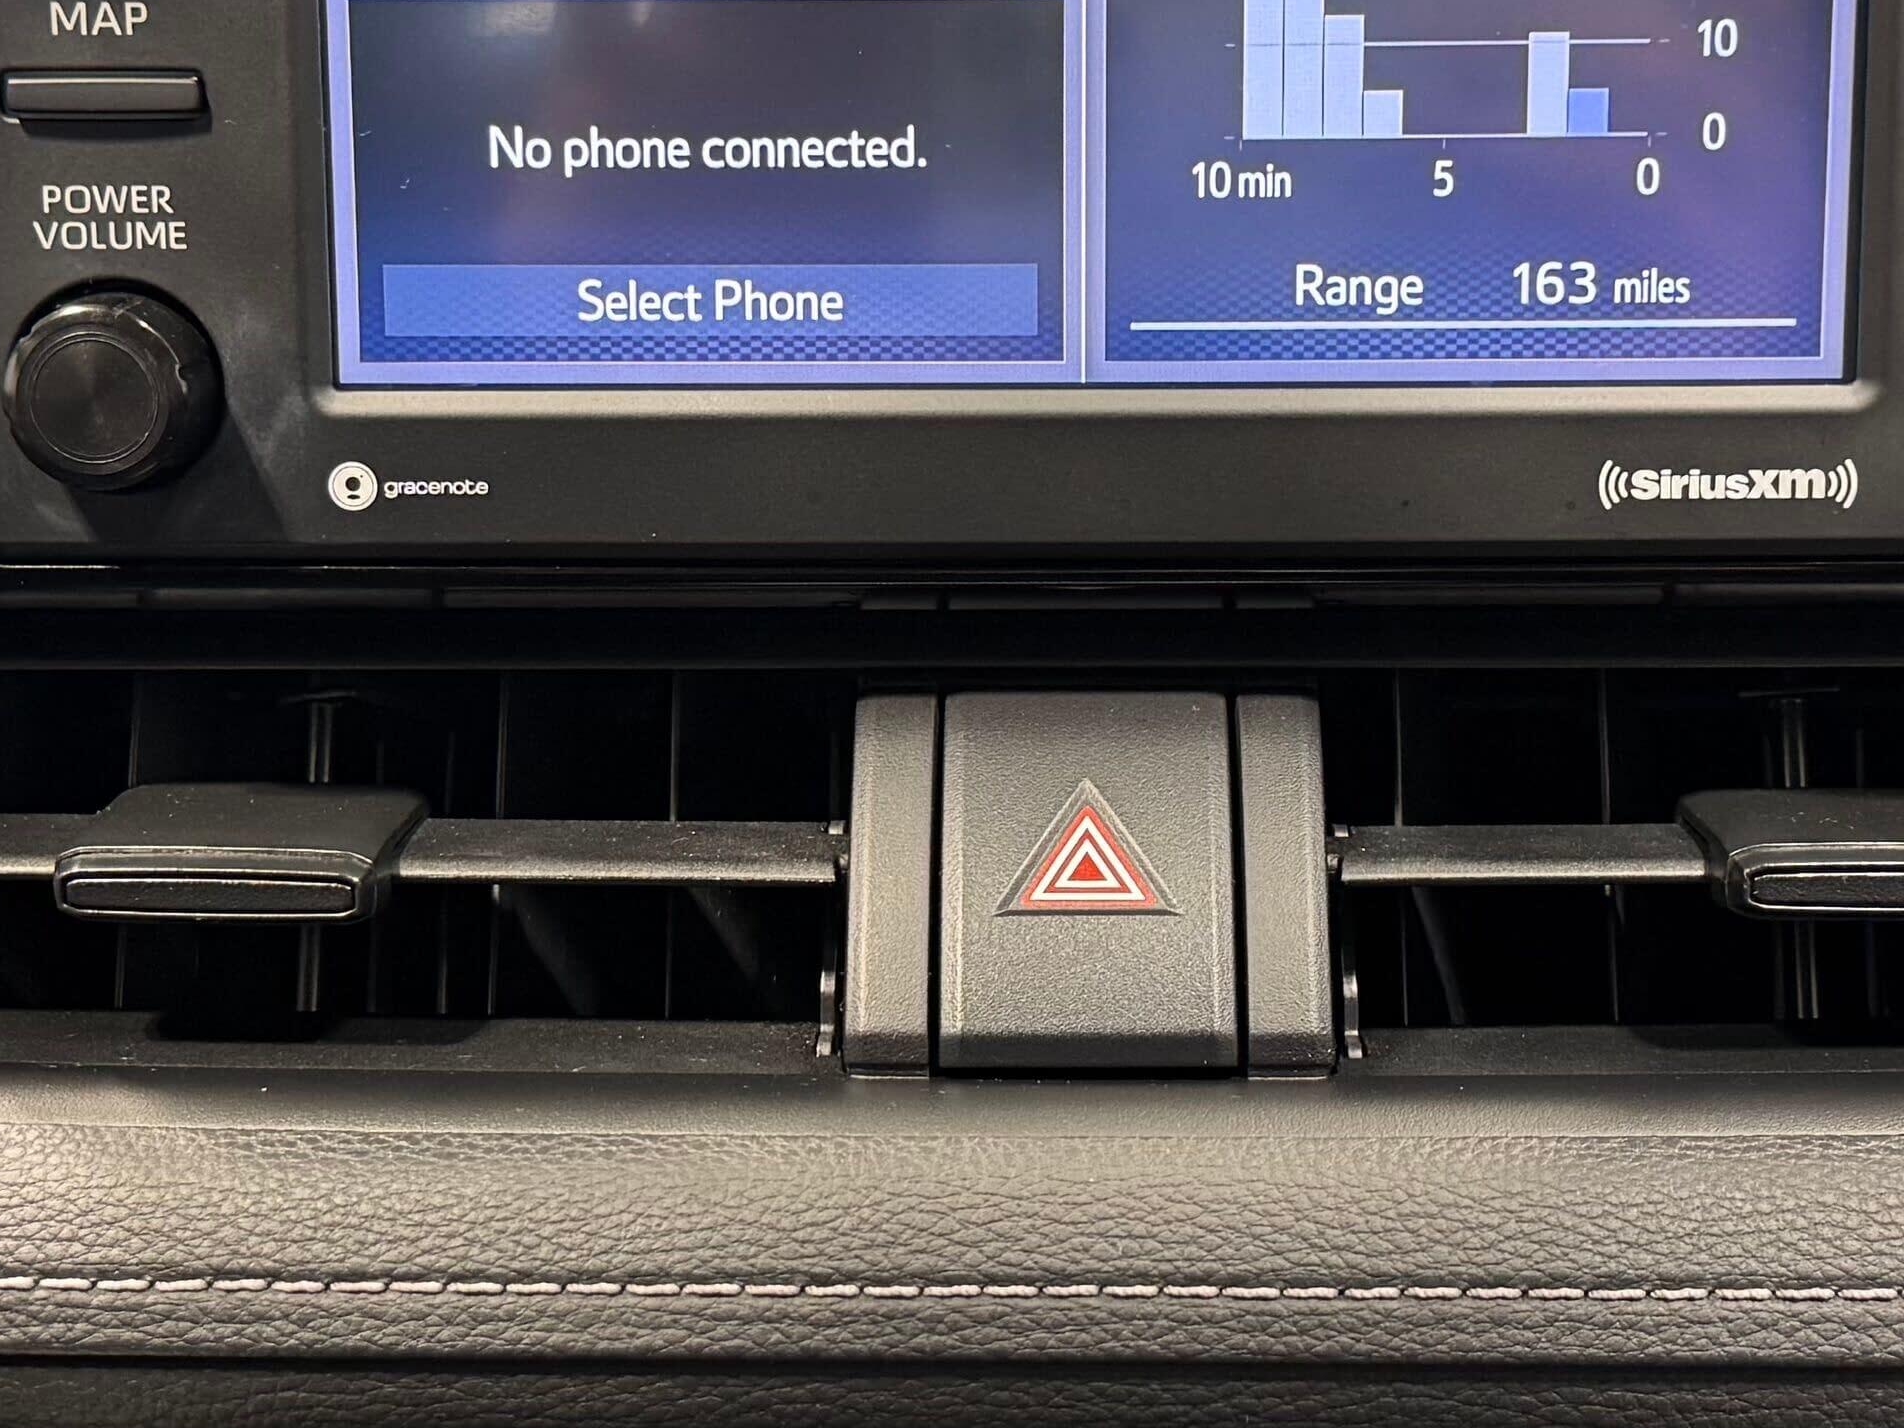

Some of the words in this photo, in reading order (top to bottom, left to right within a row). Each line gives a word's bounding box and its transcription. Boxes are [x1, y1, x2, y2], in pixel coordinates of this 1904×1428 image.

[49, 1, 148, 36] MAP
[1697, 18, 1738, 58] 10
[1702, 111, 1727, 151] 0
[488, 124, 552, 169] No
[563, 125, 692, 179] phone
[701, 123, 928, 169] connected.
[1191, 160, 1232, 199] 10
[1238, 163, 1292, 199] min
[1432, 160, 1455, 198] 5
[1636, 157, 1660, 196] 0
[42, 184, 174, 214] POWER
[32, 220, 188, 250] VOLUME
[576, 278, 702, 322] Select
[713, 276, 844, 322] Phone
[1295, 263, 1425, 315] Range
[1511, 261, 1597, 305] 163
[1613, 266, 1692, 305] miles
[383, 479, 489, 499] gracenote
